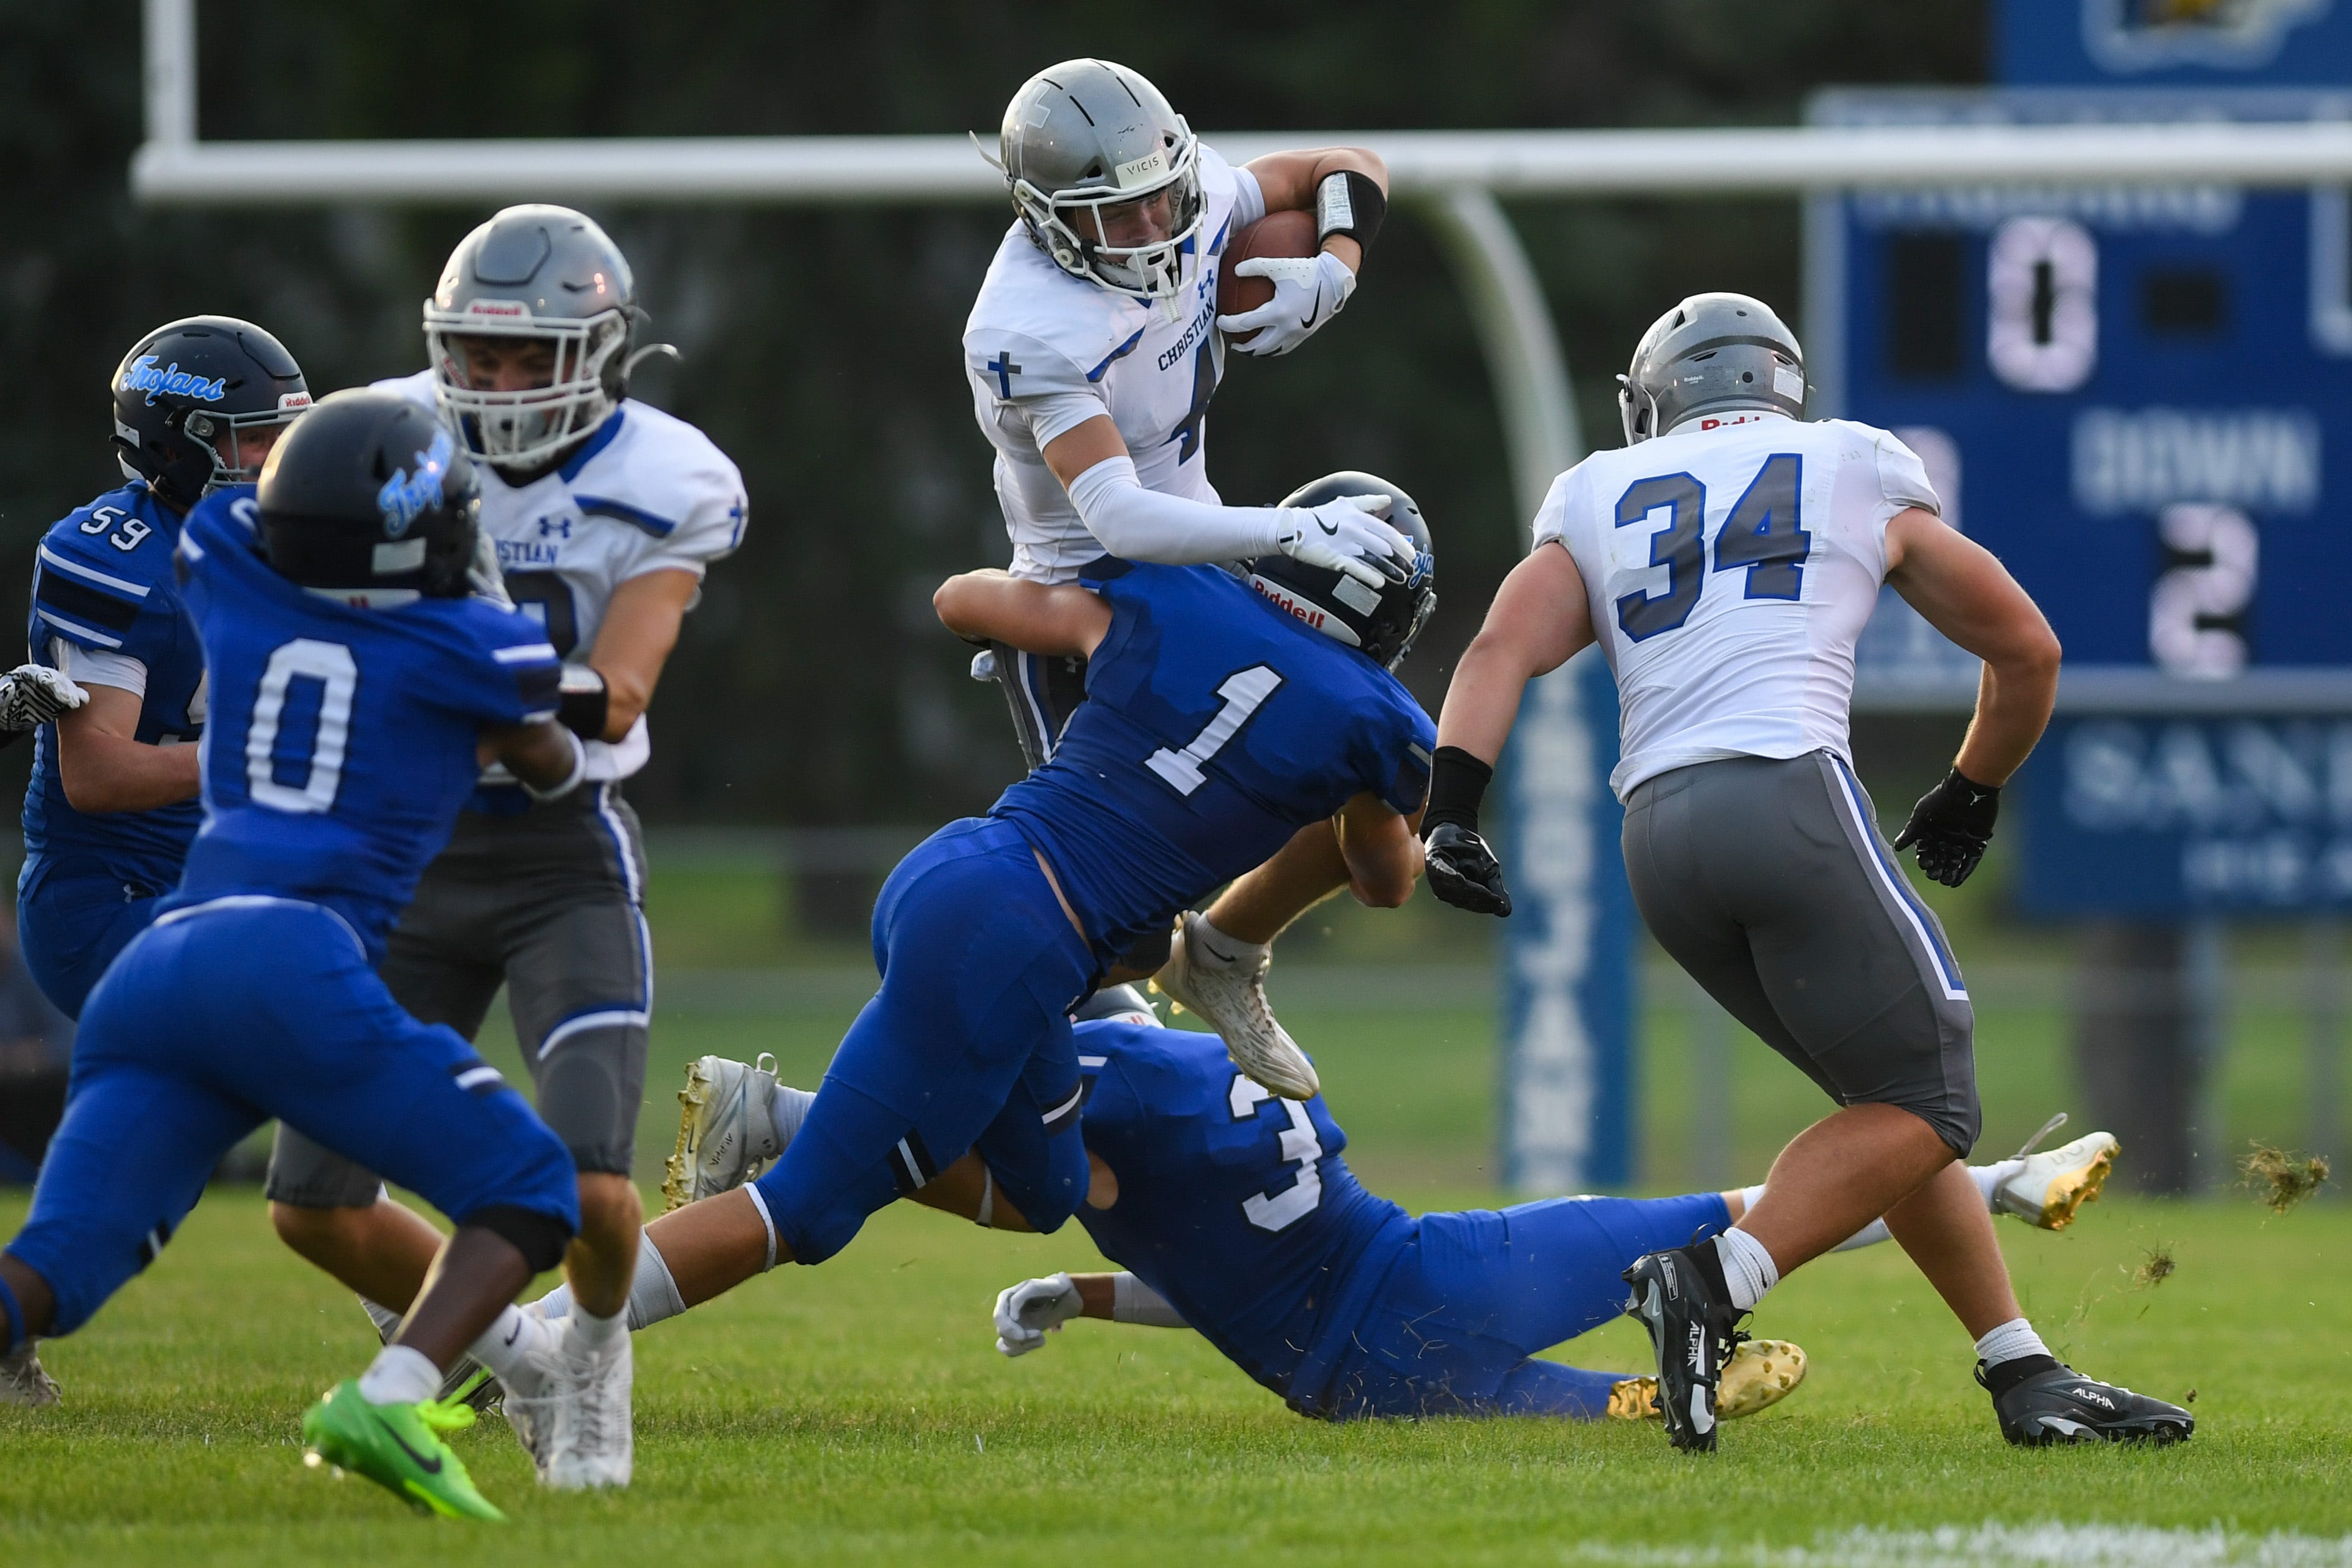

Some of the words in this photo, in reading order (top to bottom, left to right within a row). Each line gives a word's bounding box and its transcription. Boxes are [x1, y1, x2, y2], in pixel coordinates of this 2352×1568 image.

[1126, 156, 1160, 175] VICIS
[1157, 296, 1215, 372] CHRISTIAN
[1988, 216, 2096, 391] 0
[120, 355, 226, 406] Trojans
[2073, 409, 2320, 514] DOWN
[80, 505, 152, 551] 59
[1615, 452, 1811, 643] 34
[1254, 579, 1326, 629] Riddell
[2150, 504, 2260, 681] 2
[246, 637, 358, 813] 0
[1144, 664, 1284, 797] 1
[1229, 1072, 1323, 1233] 3
[1686, 1319, 1700, 1367] ALPHA
[2072, 1387, 2116, 1410] ALPHA
